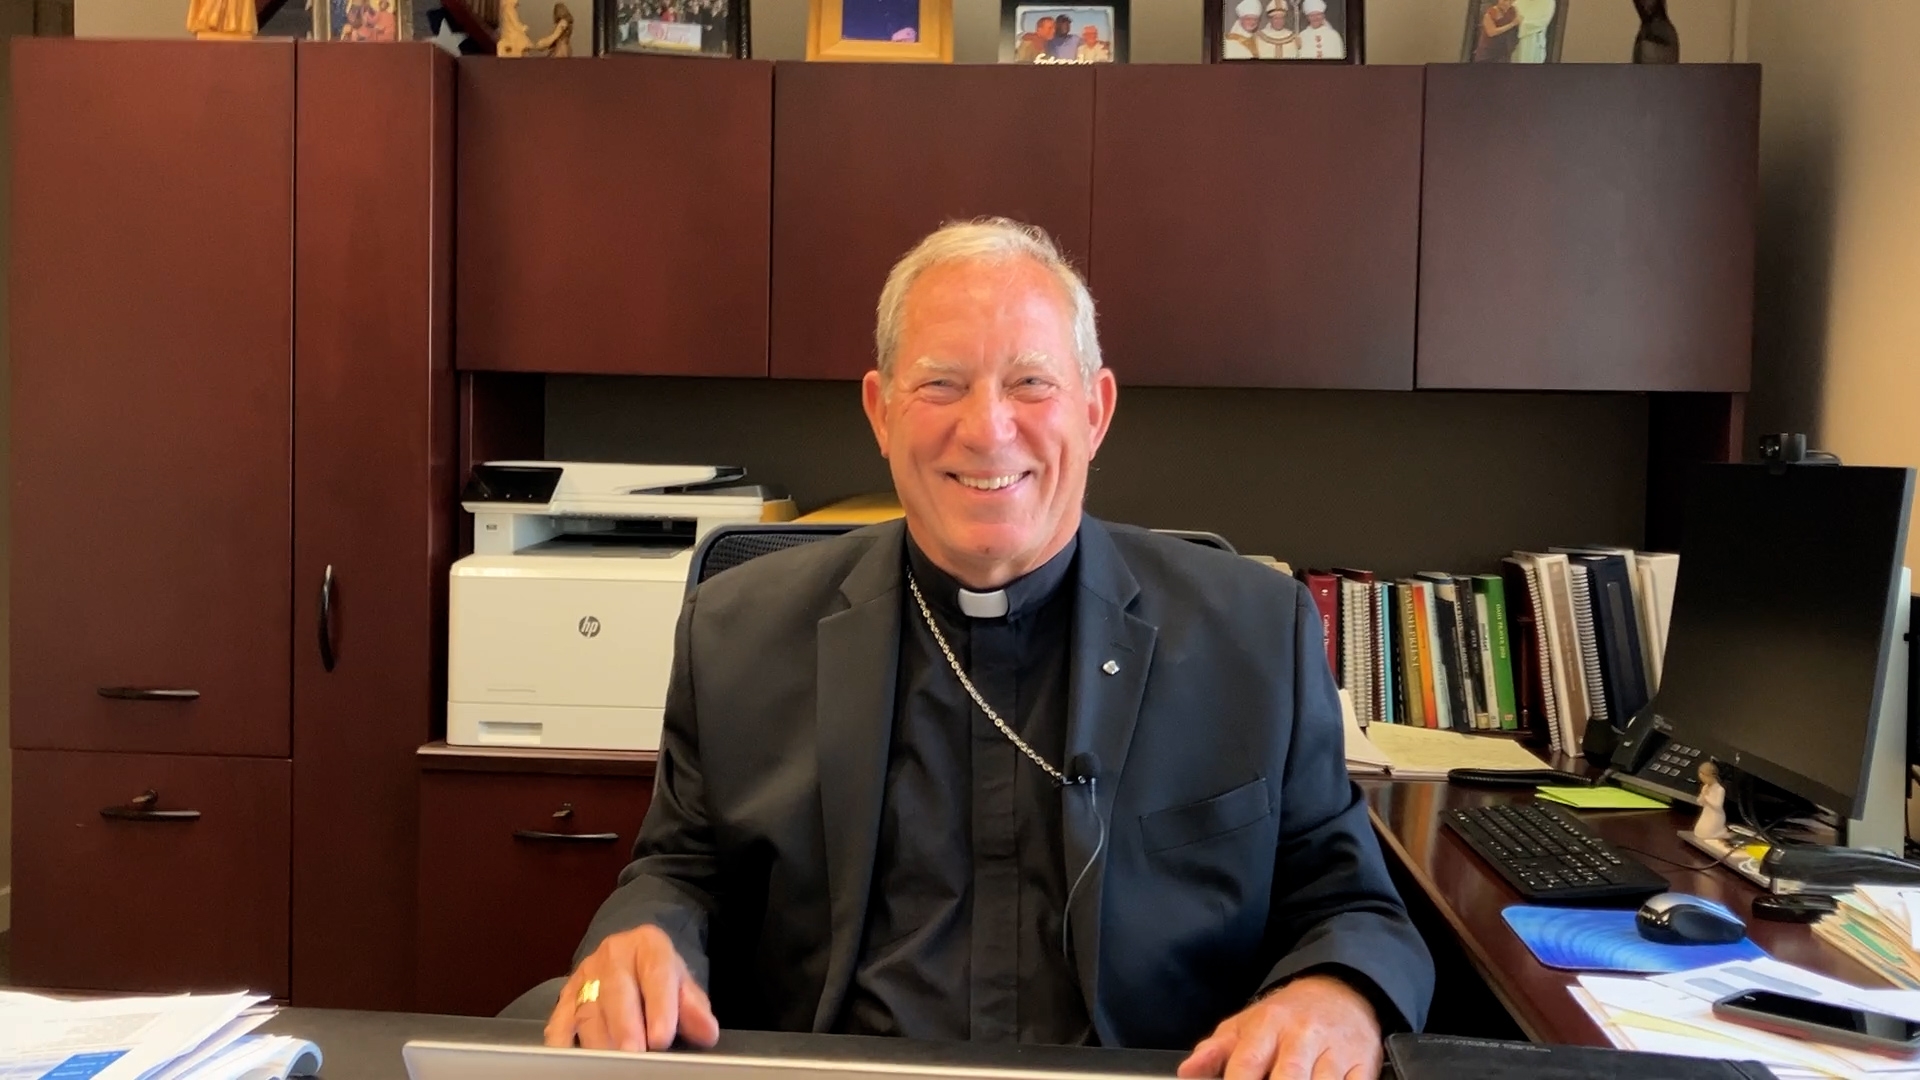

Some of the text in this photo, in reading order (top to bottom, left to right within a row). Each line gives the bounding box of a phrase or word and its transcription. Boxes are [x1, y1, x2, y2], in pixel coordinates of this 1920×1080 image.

[580, 616, 599, 638] hp
[1405, 590, 1420, 667] PARISH PRIEST
